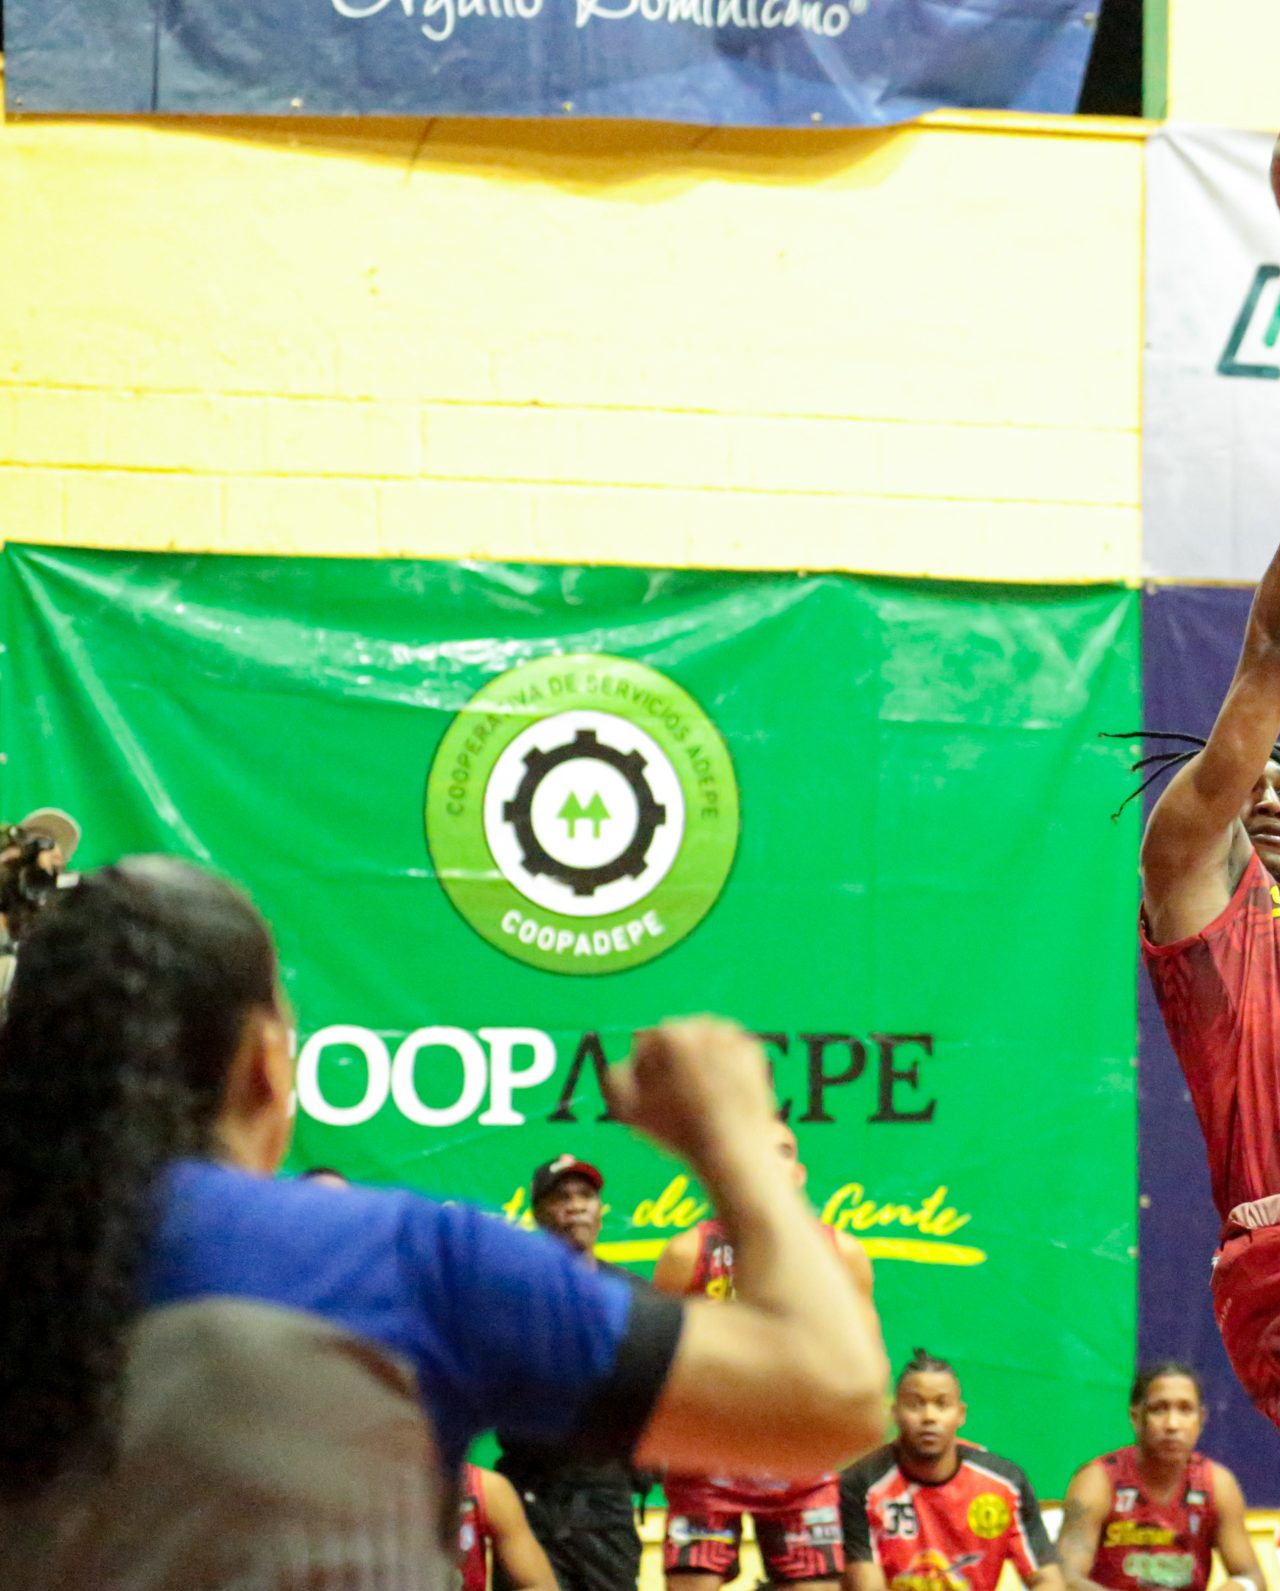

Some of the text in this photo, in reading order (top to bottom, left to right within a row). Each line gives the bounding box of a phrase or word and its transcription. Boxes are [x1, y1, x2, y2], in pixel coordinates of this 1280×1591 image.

[548, 674, 578, 696] DE
[501, 909, 666, 956] COOPADEPE
[288, 1024, 936, 1126] OOPAPE
